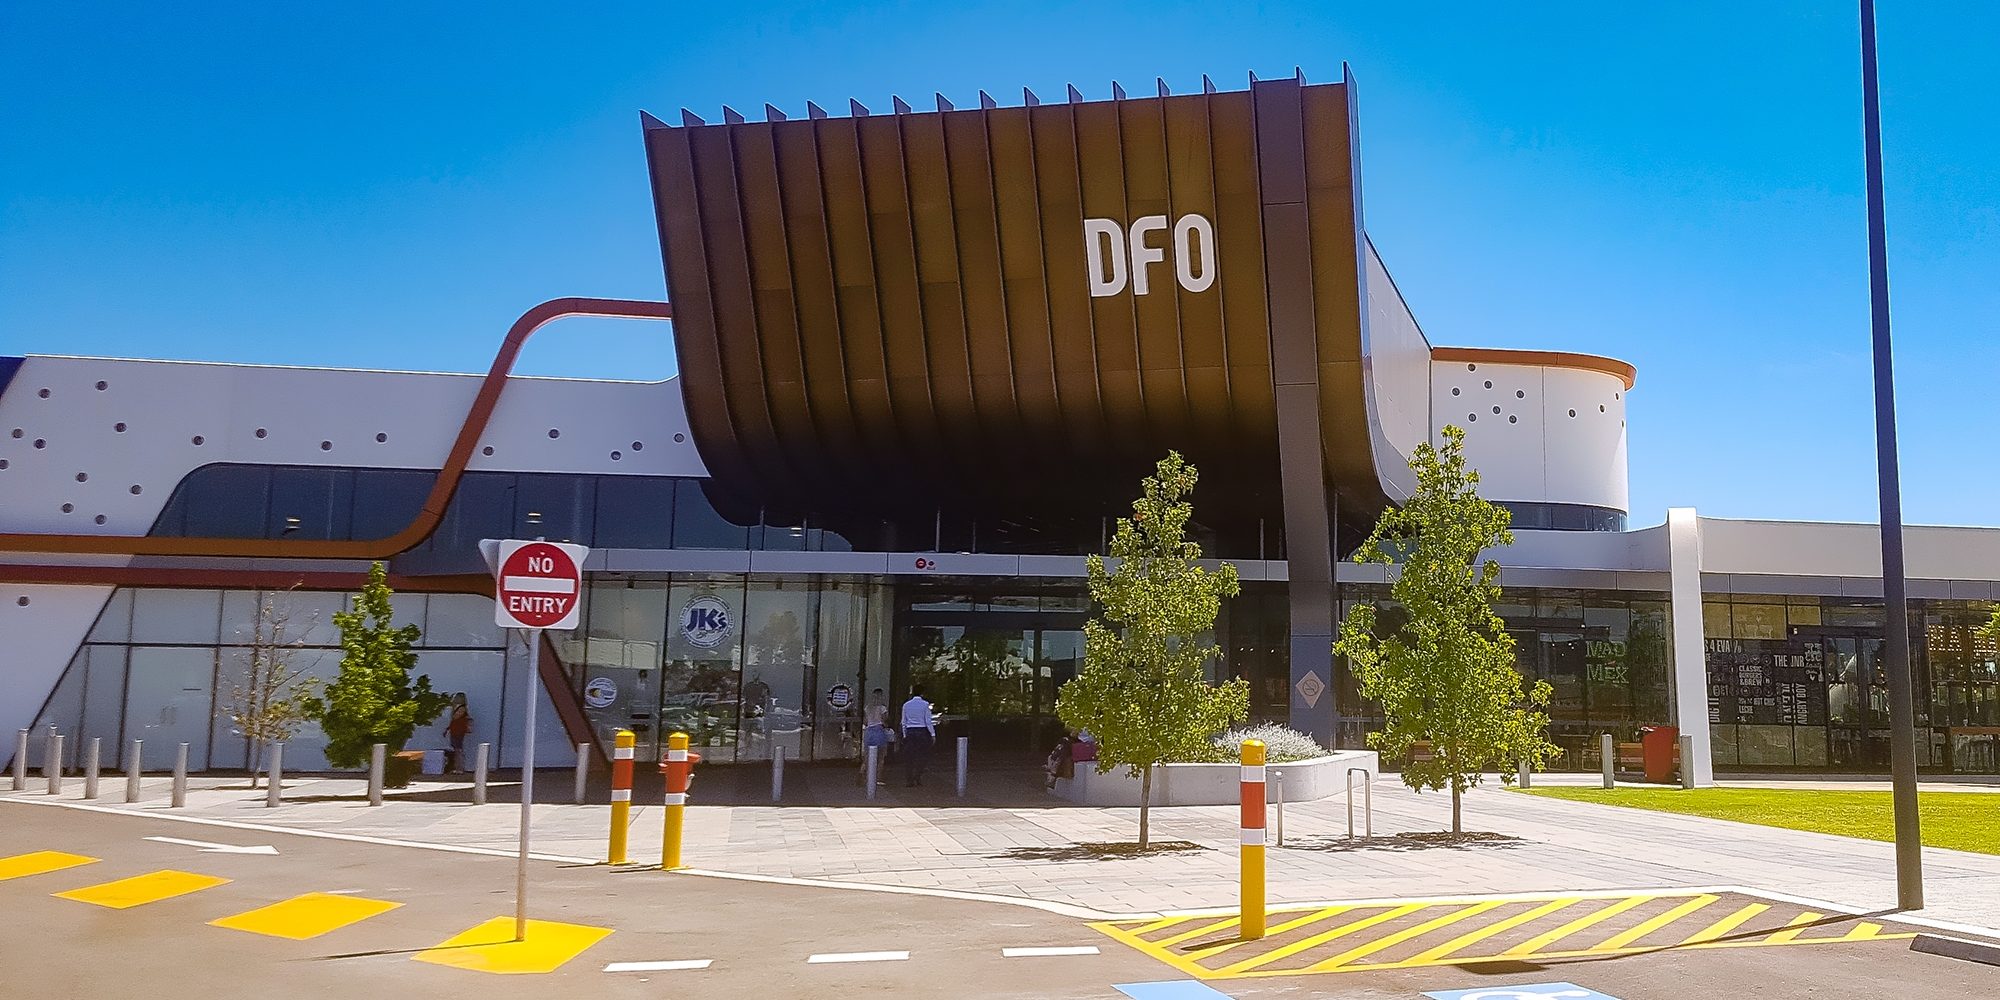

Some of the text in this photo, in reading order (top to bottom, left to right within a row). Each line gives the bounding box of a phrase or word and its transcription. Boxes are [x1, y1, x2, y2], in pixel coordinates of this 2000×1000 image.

[1084, 213, 1216, 297] DFO
[528, 556, 554, 574] NO
[509, 596, 568, 613] ENTRY
[1585, 641, 1626, 658] MAD
[1773, 655, 1788, 668] THE
[1586, 663, 1630, 684] MEX
